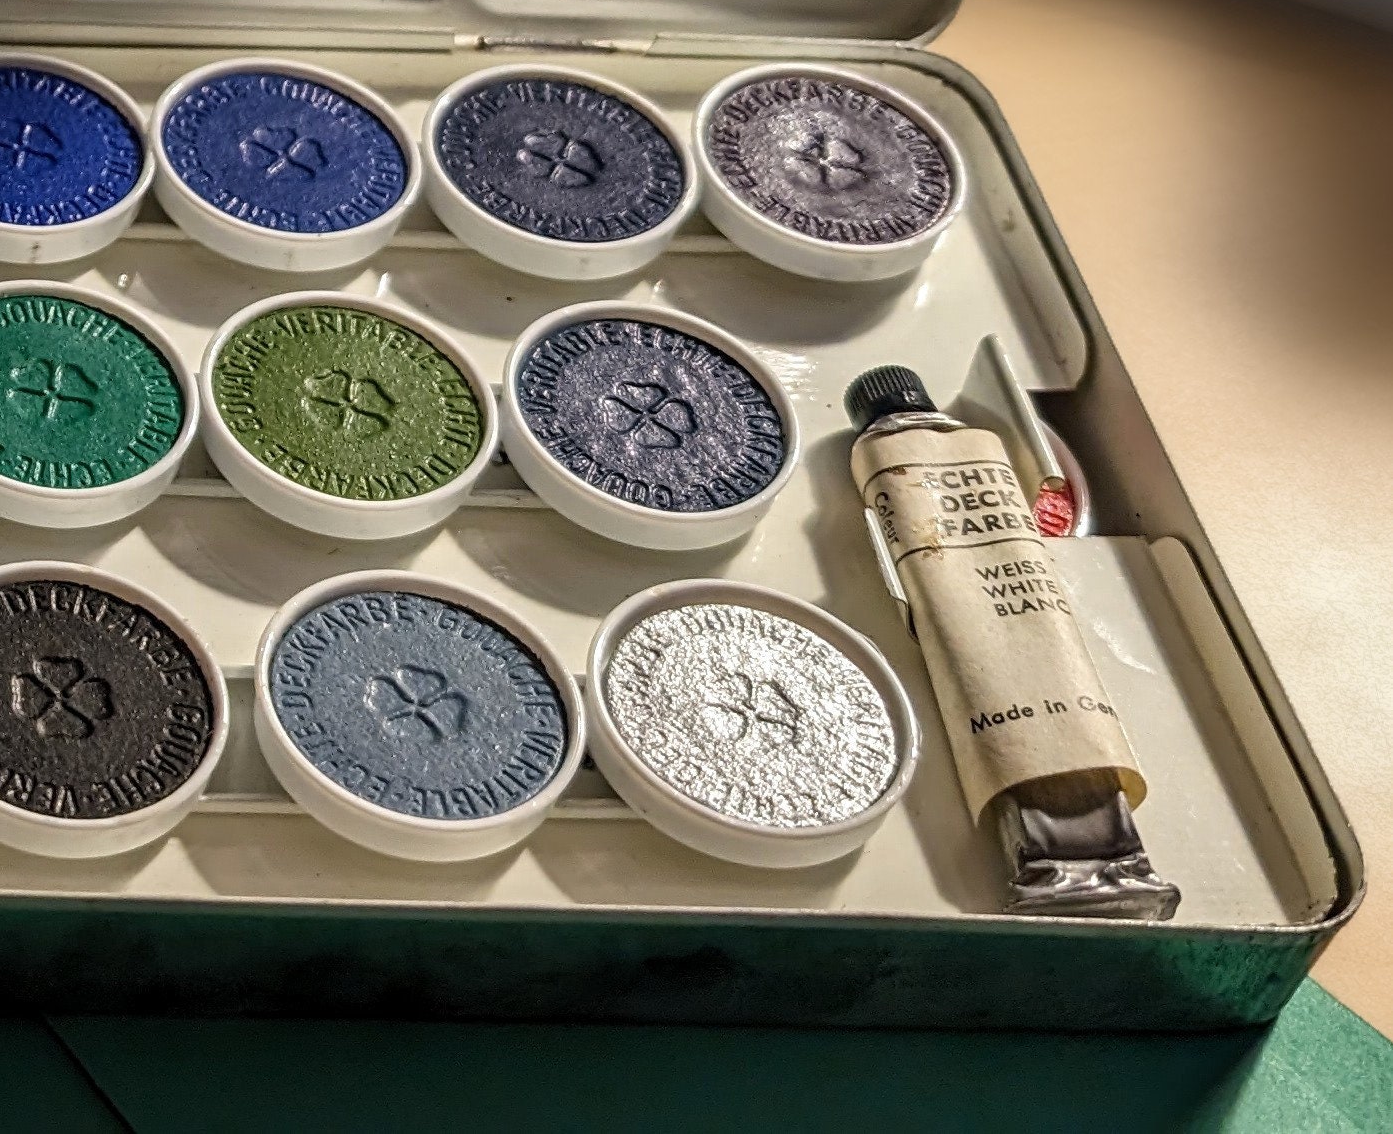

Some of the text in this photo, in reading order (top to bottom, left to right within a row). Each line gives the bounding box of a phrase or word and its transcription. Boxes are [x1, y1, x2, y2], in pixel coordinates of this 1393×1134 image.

[923, 467, 1016, 489] ECHTE
[941, 488, 1021, 512] DECK
[941, 512, 1037, 537] FARBE
[974, 560, 1047, 581] WEISS
[981, 578, 1059, 598] WHITE
[993, 597, 1071, 617] BLANC
[969, 695, 1119, 734] Made in Ger
[406, 727, 560, 817] VERITABLE
